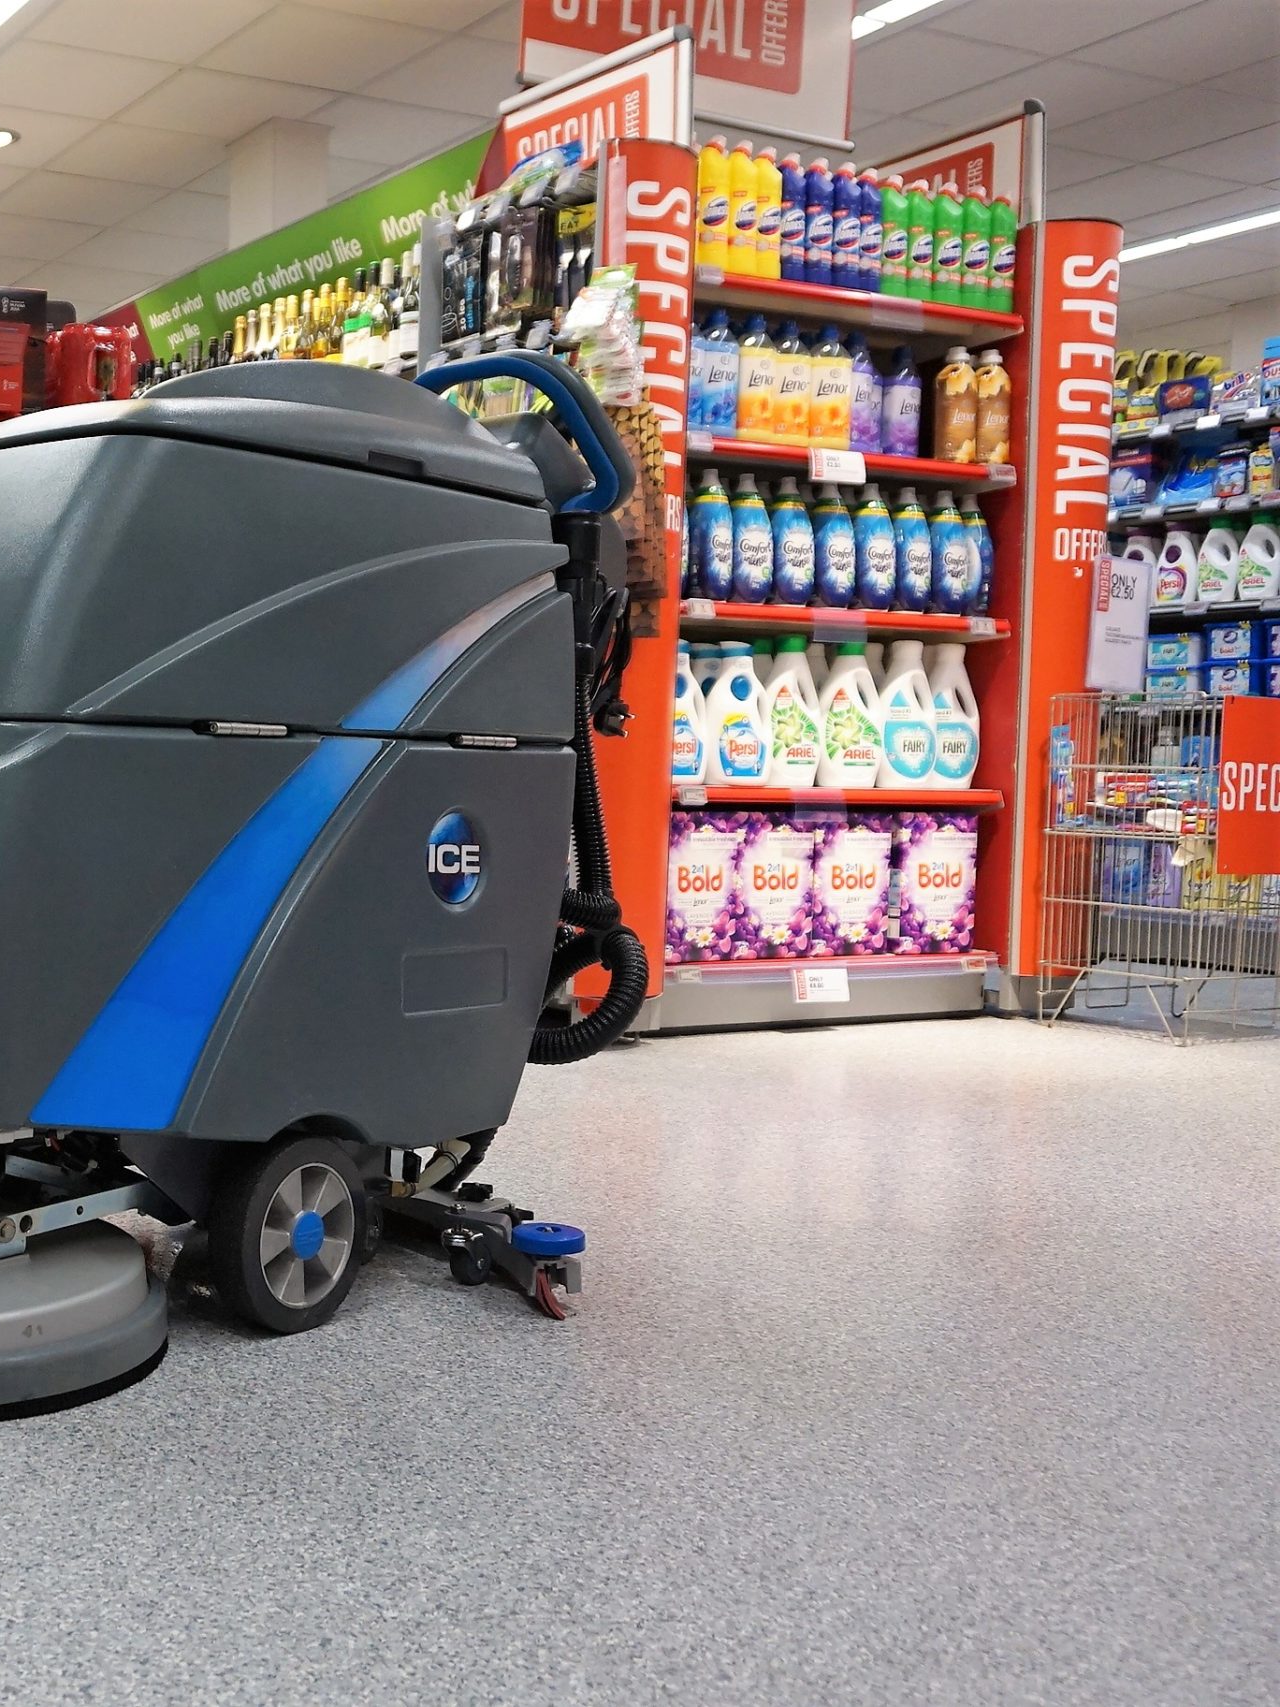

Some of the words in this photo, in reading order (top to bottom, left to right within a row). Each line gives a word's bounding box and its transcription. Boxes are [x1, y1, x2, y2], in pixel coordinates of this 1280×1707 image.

[554, 0, 752, 59] CIAL
[761, 0, 788, 65] OFFER
[381, 208, 424, 244] More
[430, 190, 450, 217] of
[216, 284, 252, 312] More
[253, 270, 268, 297] of
[268, 261, 304, 291] what
[304, 252, 334, 283] you
[333, 235, 363, 264] like
[149, 310, 172, 330] More
[172, 302, 182, 319] of
[181, 293, 204, 315] what
[168, 330, 185, 350] you
[183, 323, 200, 339] like
[855, 384, 870, 402] Len
[1054, 254, 1120, 517] SPECIAL
[900, 399, 920, 415] Leno
[1111, 573, 1138, 588] ONLY
[1111, 585, 1135, 600] €2.50
[729, 737, 759, 759] Persil
[786, 747, 817, 758] ARIEL
[843, 749, 875, 760] ARIEL
[903, 739, 927, 753] FAIRY
[942, 741, 968, 754] FAIRY
[428, 843, 481, 874] ICE
[678, 863, 723, 893] Bold
[754, 863, 799, 891] Bold
[832, 863, 878, 890] Bold
[918, 862, 964, 889] Bold
